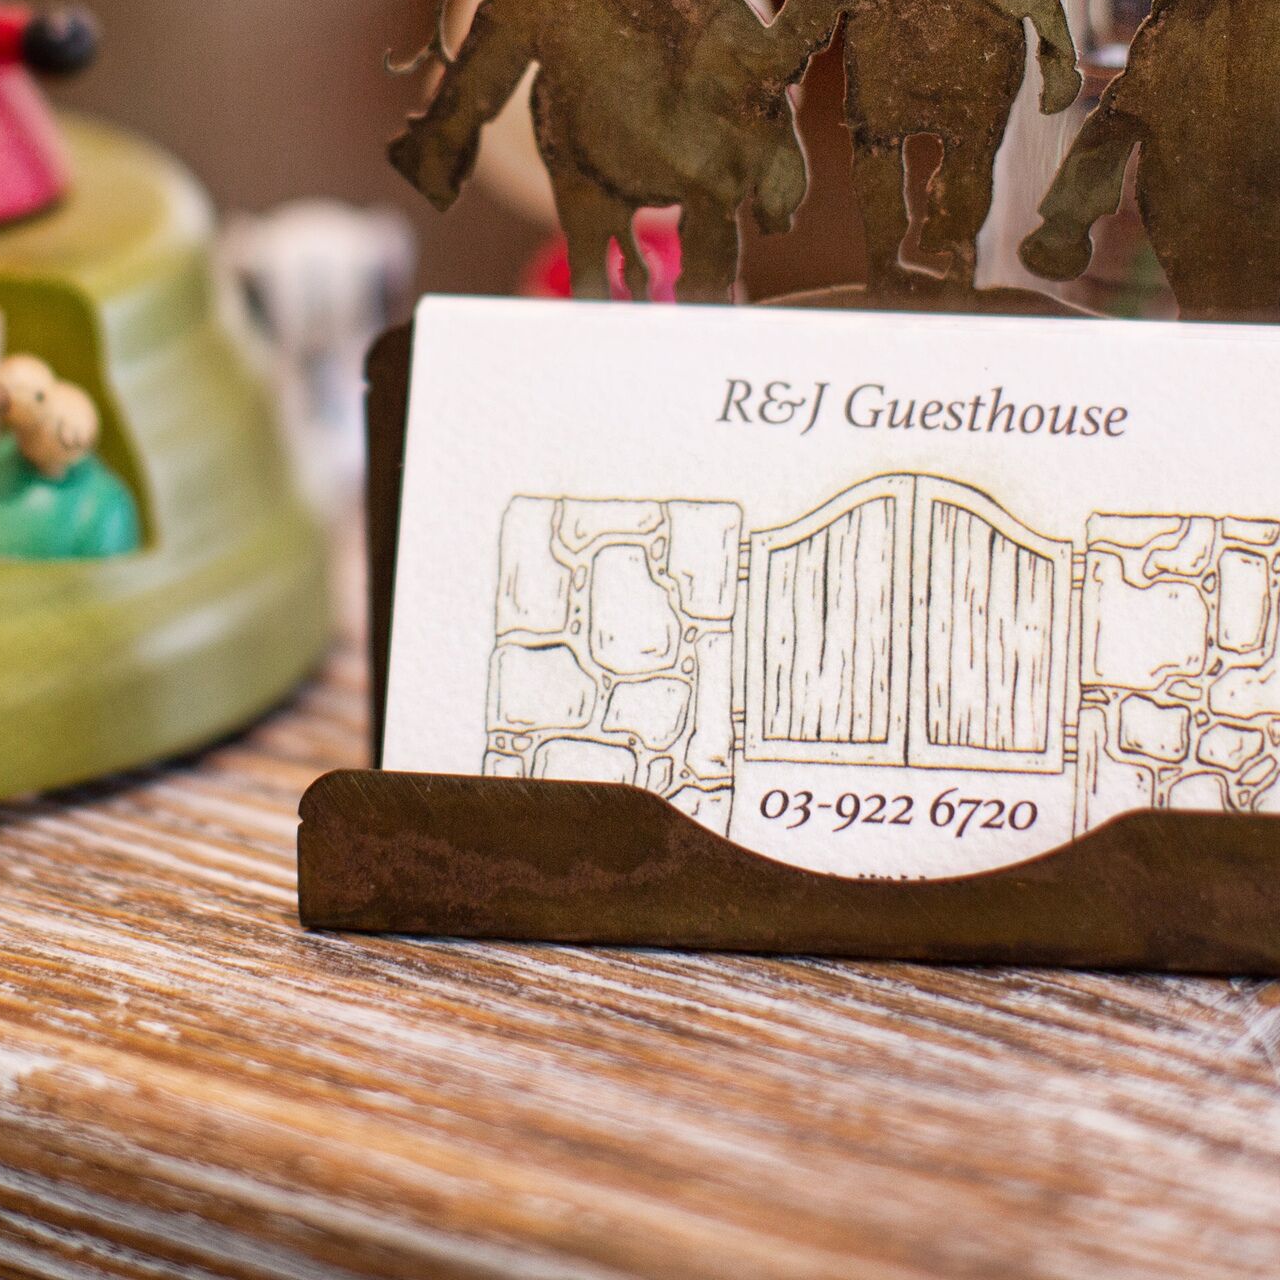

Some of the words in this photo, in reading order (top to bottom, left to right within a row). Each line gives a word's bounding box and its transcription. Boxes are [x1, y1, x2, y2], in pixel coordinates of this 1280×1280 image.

[716, 377, 831, 436] R&J
[842, 382, 1130, 438] Guesthouse
[759, 788, 914, 833] 03-922
[929, 786, 1039, 839] 6720
